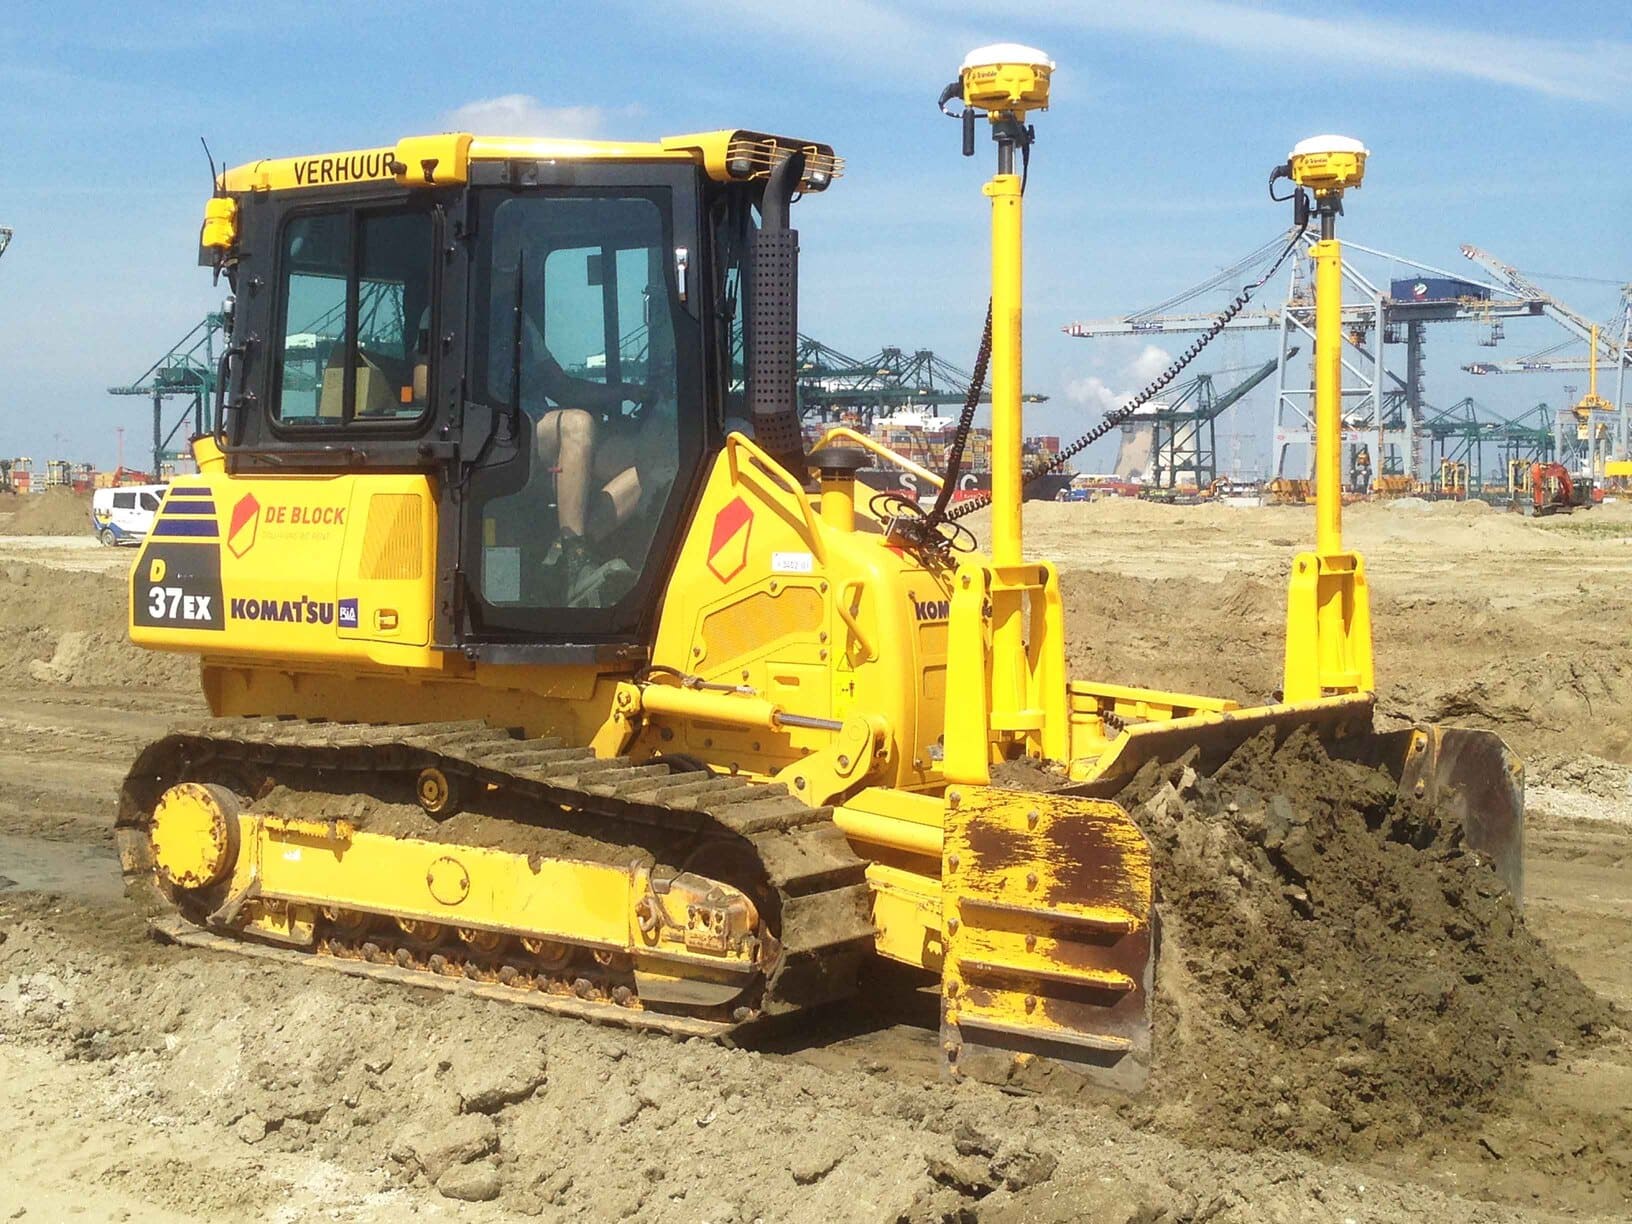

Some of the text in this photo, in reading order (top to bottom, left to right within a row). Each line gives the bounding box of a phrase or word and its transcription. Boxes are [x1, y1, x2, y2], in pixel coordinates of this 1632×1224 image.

[294, 151, 396, 185] VERHUUR
[264, 506, 346, 525] DE BLOCK
[149, 558, 167, 583] D
[148, 586, 212, 620] 37EX
[230, 595, 333, 625] KOMATSU
